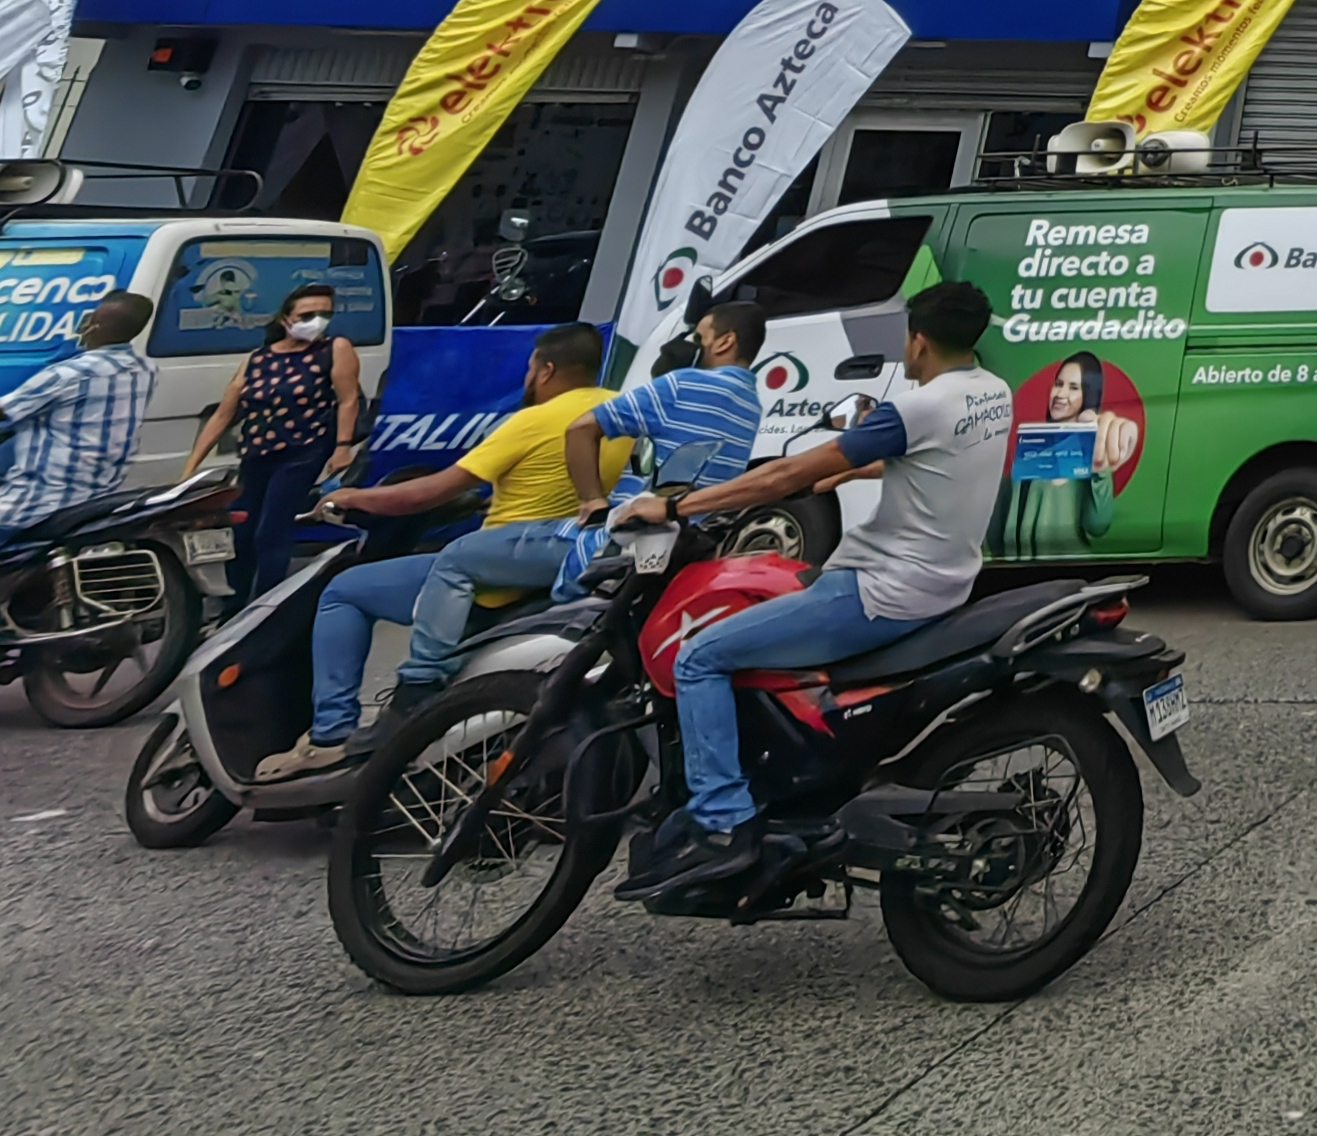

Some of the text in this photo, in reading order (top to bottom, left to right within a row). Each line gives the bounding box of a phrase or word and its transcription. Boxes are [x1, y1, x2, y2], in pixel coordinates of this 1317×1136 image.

[1174, 74, 1213, 123] Creamos
[1210, 16, 1252, 74] momentos
[684, 2, 839, 242] Banco Azteca
[1025, 219, 1149, 246] Remesa
[1017, 248, 1155, 277] directo a
[1010, 282, 1158, 309] tu cuenta
[1002, 310, 1187, 342] Guardadito
[1192, 365, 1263, 384] Abierto
[1267, 365, 1292, 382] de
[1296, 364, 1309, 382] 8
